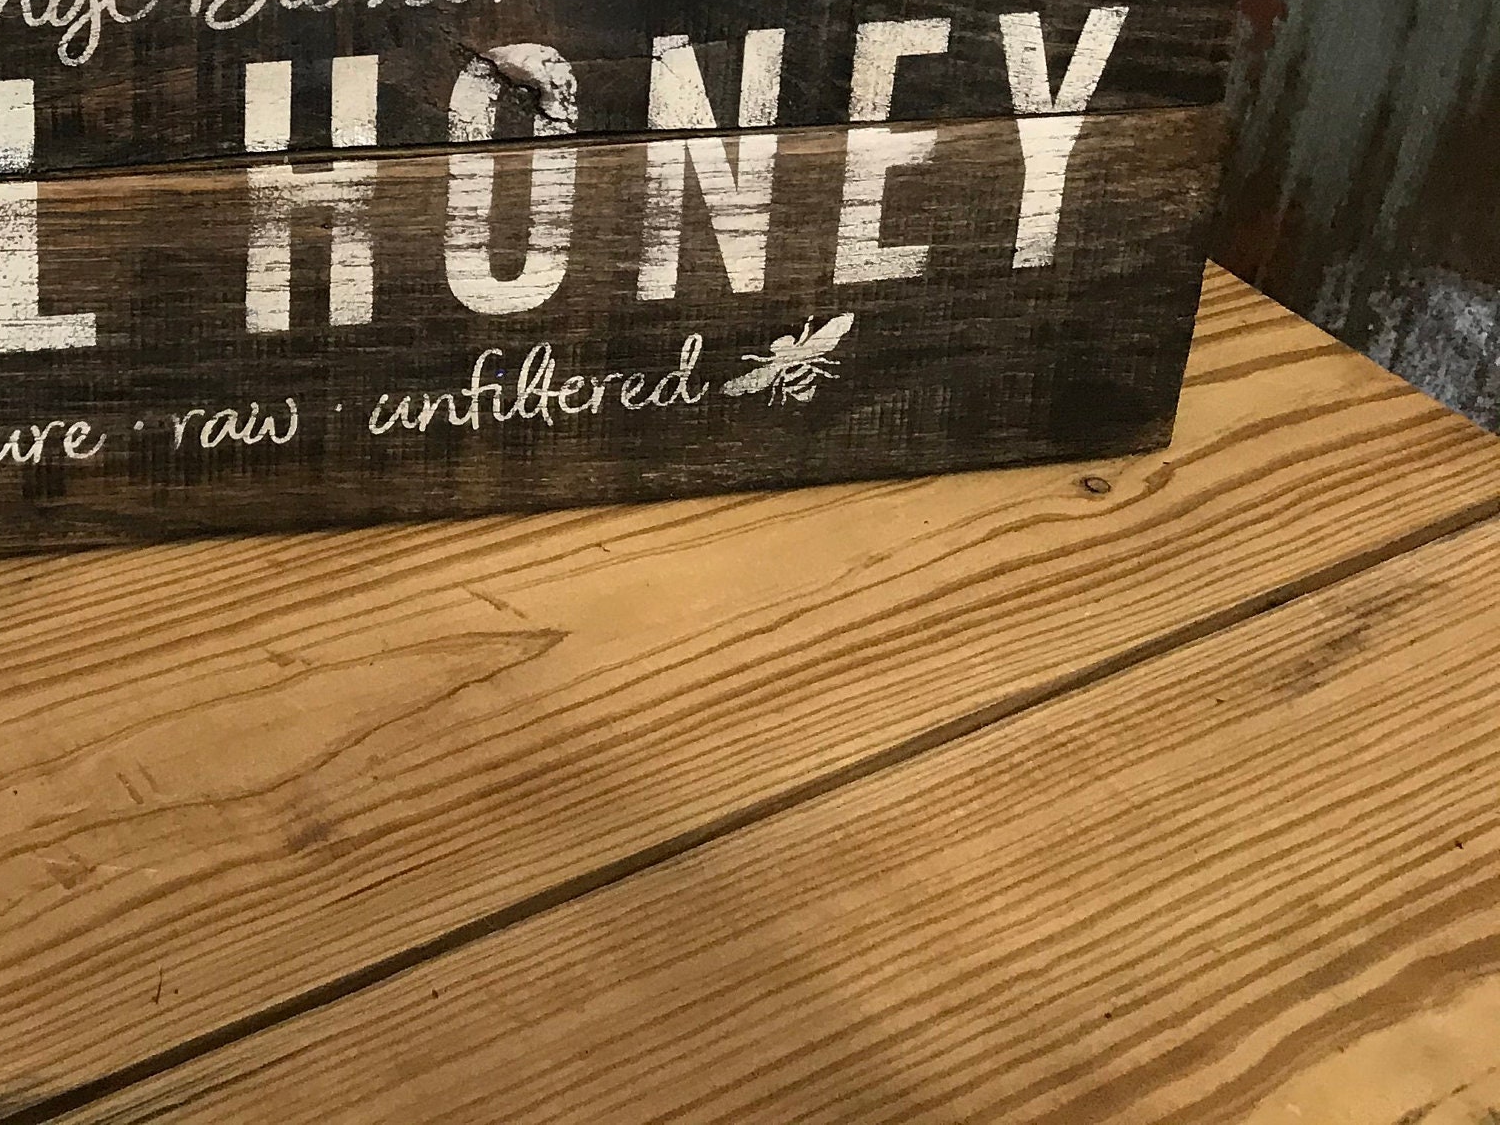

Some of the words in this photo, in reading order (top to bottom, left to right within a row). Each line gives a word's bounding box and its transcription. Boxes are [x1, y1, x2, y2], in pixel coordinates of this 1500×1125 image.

[244, 5, 1129, 334] HONEY
[172, 396, 299, 451] raw
[368, 332, 710, 436] unfiltered
